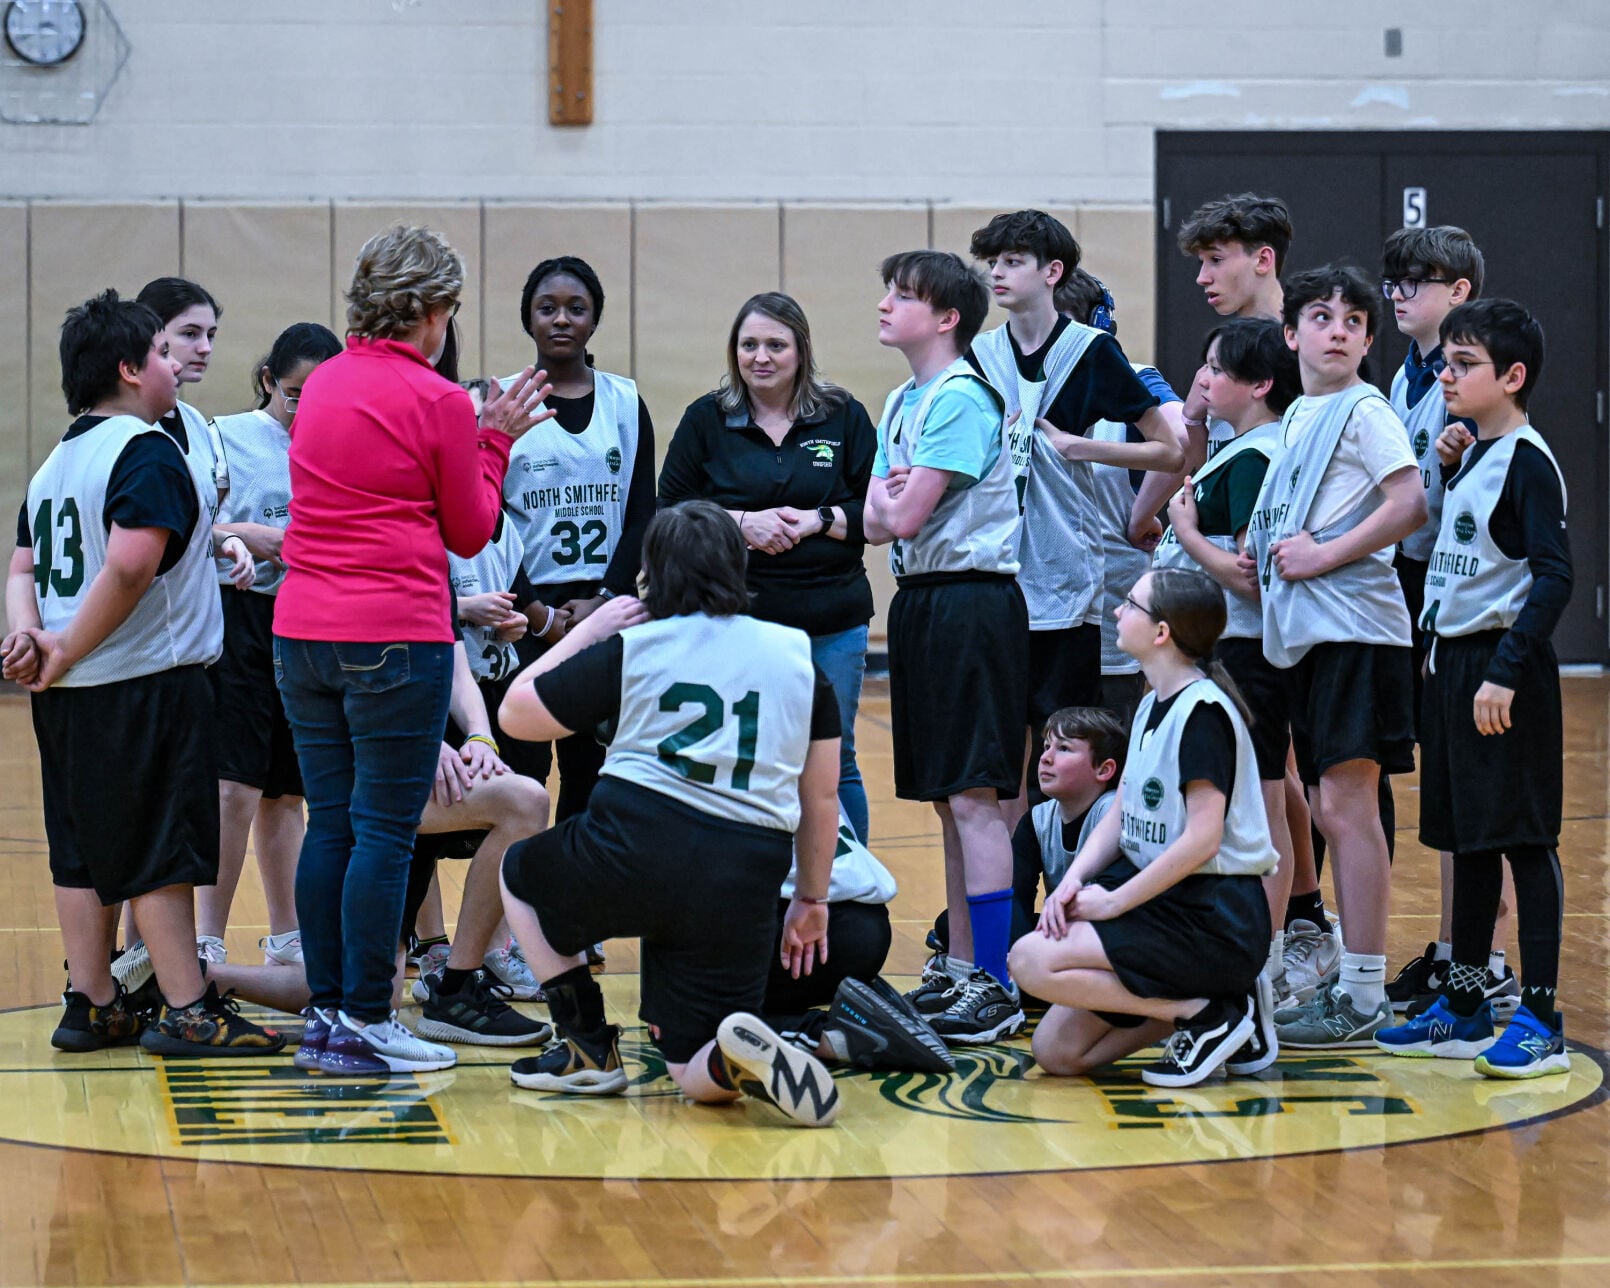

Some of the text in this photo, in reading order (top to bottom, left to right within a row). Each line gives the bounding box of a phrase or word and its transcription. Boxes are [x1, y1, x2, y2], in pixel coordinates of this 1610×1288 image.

[1406, 193, 1421, 225] 5
[522, 486, 561, 511] NORTH
[554, 504, 605, 519] MIDDLE SCHOOL
[33, 496, 85, 598] 43
[550, 519, 608, 566] 32
[657, 681, 760, 791] 21
